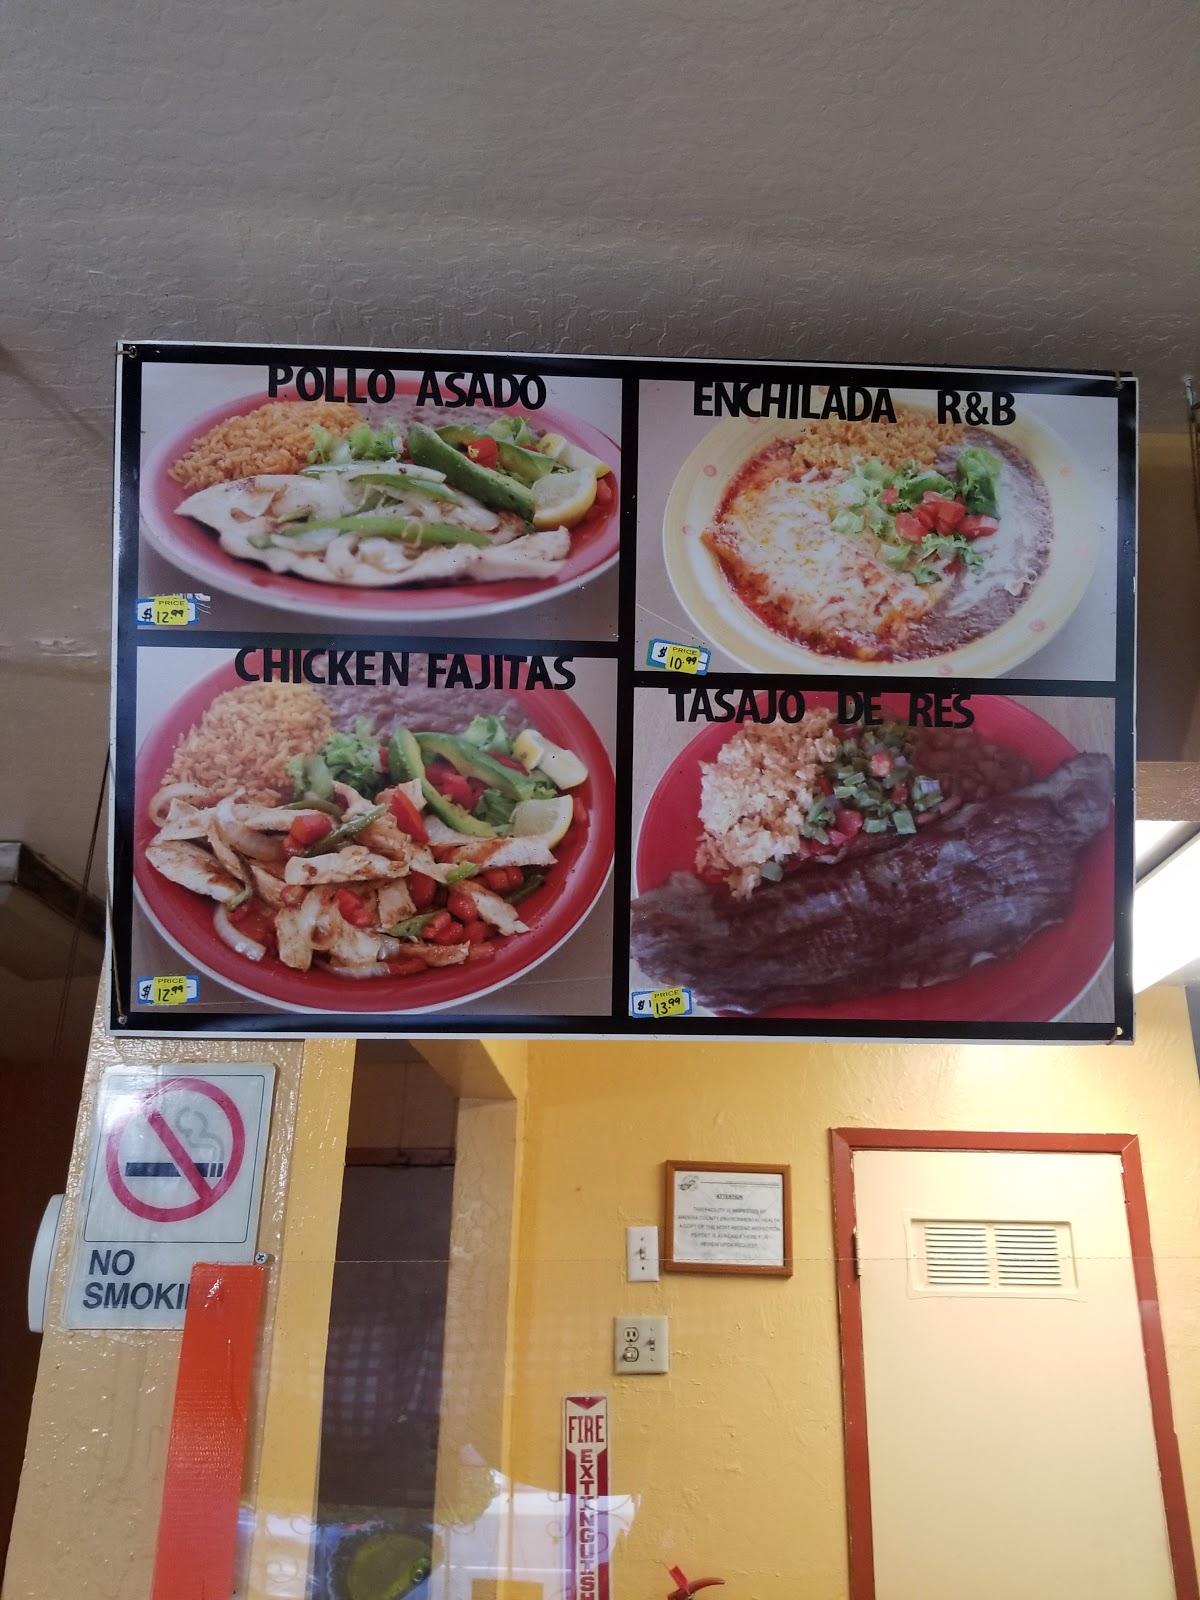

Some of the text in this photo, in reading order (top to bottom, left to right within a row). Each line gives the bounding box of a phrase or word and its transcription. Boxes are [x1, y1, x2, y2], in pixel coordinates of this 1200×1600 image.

[268, 365, 547, 410] POLLO ASADO
[693, 381, 1017, 427] ENCHILADA R&B
[672, 646, 698, 656] PRICE
[234, 647, 577, 691] CHICKEN FAJITAS
[668, 687, 975, 729] TASAJO DE RES
[88, 1249, 135, 1276] NO
[83, 1282, 191, 1310] SMOKI
[568, 1415, 605, 1444] FIRE
